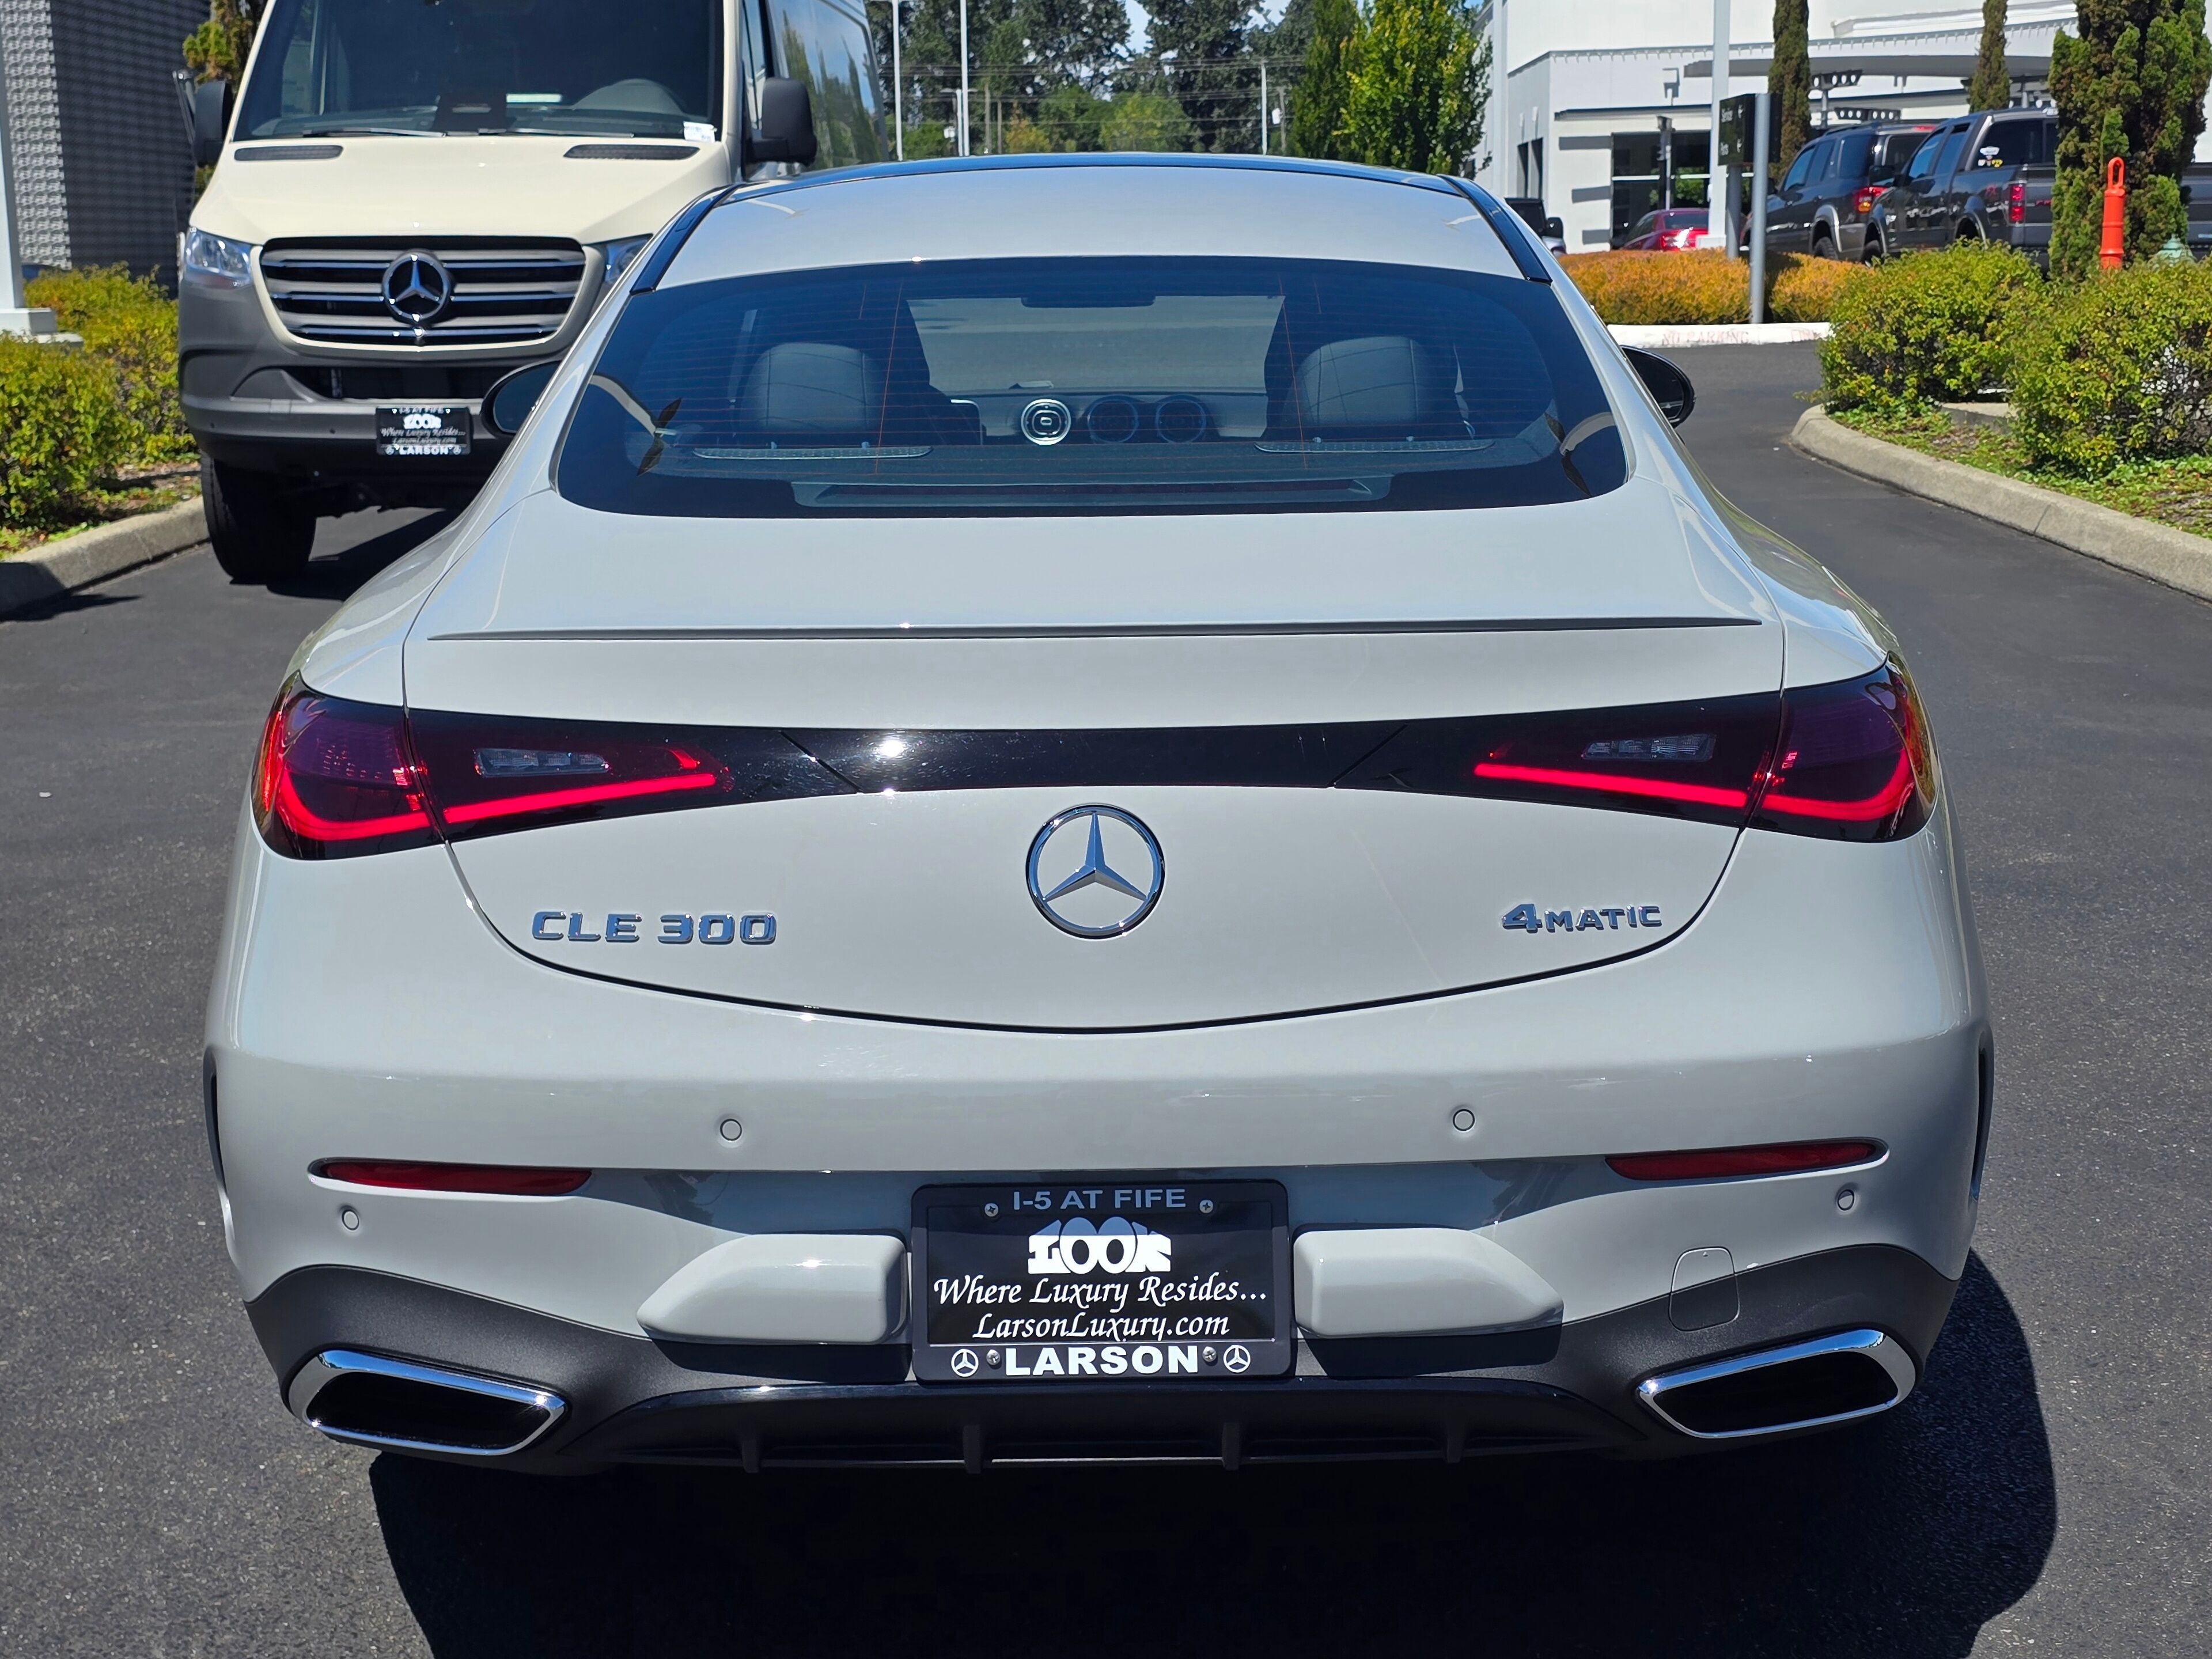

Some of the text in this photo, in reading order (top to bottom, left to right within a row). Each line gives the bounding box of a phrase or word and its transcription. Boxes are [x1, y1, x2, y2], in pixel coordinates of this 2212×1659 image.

[399, 445, 449, 455] LARSON
[532, 911, 777, 945] CLE 300
[1501, 903, 1662, 933] 4MATIC
[1013, 1188, 1187, 1210] I-5 AT FIFE
[933, 1272, 1267, 1313] Where Luxury Resides...
[972, 1312, 1230, 1342] LarsonLuxury.com
[1006, 1345, 1198, 1376] LARSON
